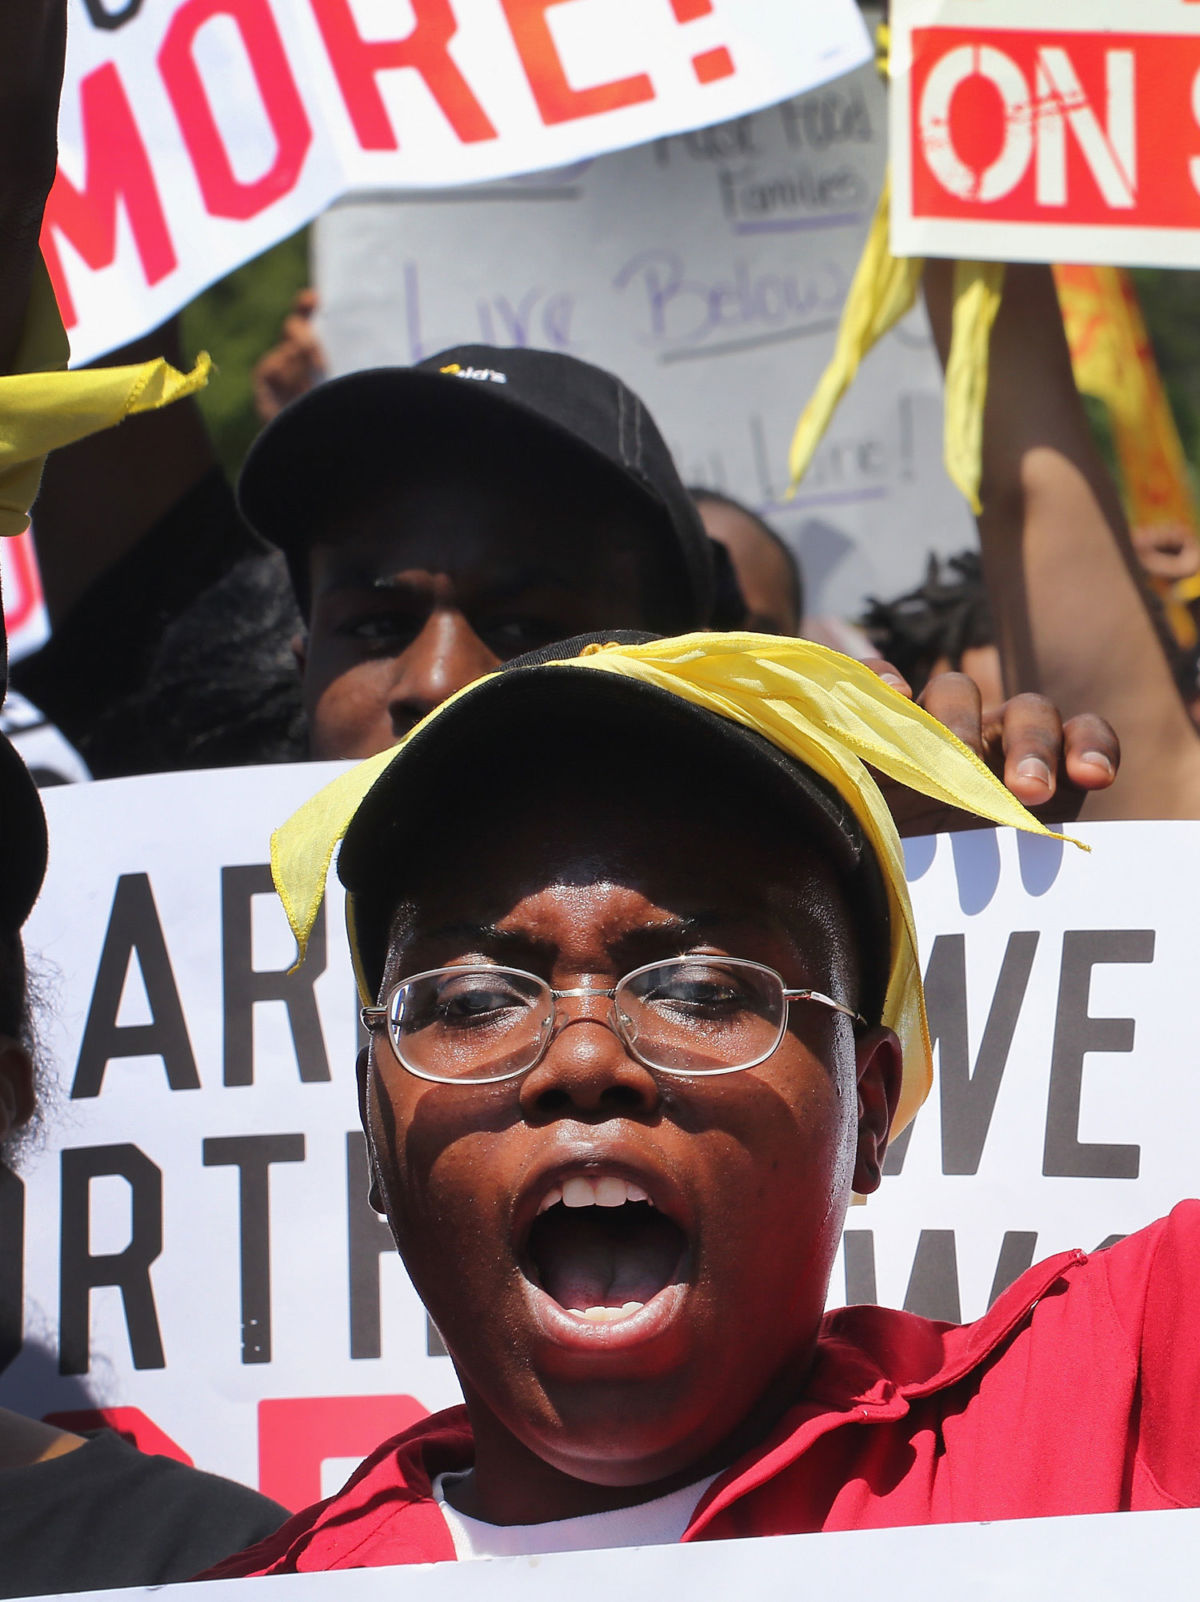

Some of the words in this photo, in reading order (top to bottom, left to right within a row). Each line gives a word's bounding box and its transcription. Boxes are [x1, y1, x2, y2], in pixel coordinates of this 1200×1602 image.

[920, 44, 1136, 208] ON
[612, 247, 856, 348] Below
[70, 864, 376, 1099] AR
[882, 928, 1156, 1179] WE
